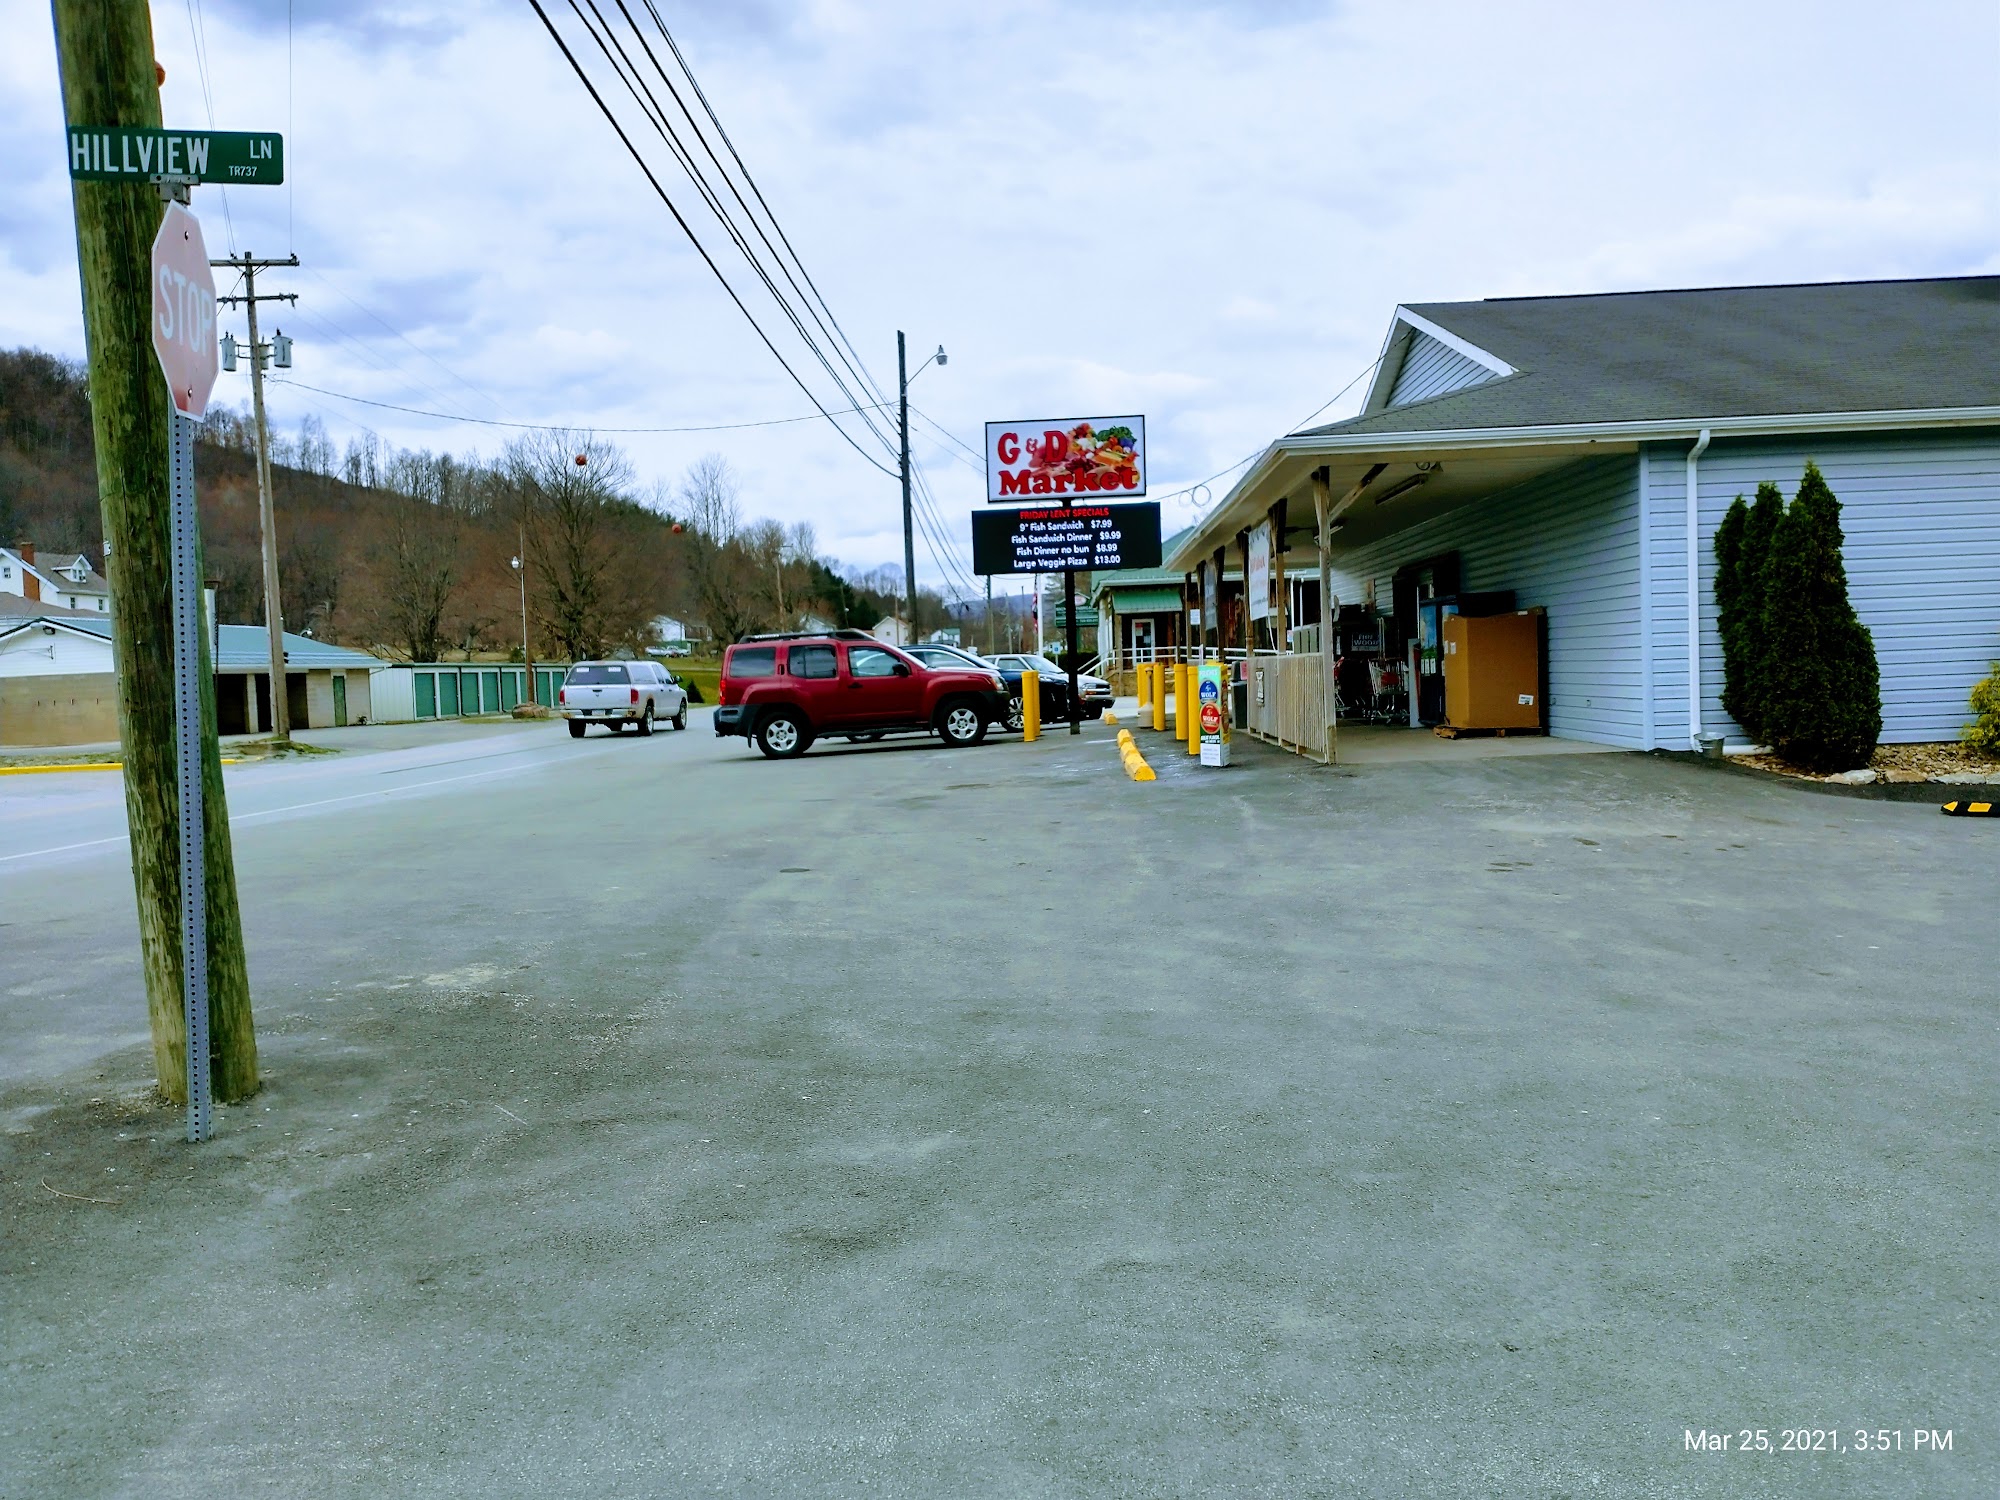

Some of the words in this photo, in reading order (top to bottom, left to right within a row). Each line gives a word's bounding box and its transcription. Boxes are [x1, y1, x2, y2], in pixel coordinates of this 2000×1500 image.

[71, 133, 210, 175] HILLVIEW
[250, 139, 272, 160] LN
[228, 165, 258, 177] TR737
[158, 264, 213, 357] STOP
[997, 432, 1021, 465] G
[1026, 438, 1038, 454] &
[1043, 430, 1068, 463] D
[998, 466, 1138, 496] Market
[1020, 510, 1049, 519] FRIDAY
[1050, 509, 1071, 518] LENT
[1072, 507, 1110, 517] SPECIALS
[1030, 522, 1046, 531] Fish
[1047, 520, 1084, 531] Sandwich
[1090, 519, 1112, 529] $7.99
[1011, 535, 1028, 544] Fish
[1029, 533, 1065, 543] Sandwich
[1066, 532, 1093, 542] Dinner
[1100, 530, 1122, 541] $9.99
[1016, 547, 1032, 556] Fish
[1033, 546, 1060, 555] Dinner
[1073, 544, 1089, 553] bun
[1096, 543, 1118, 553] $8.99
[1013, 559, 1037, 570] Large
[1037, 557, 1066, 569] Veggie
[1067, 557, 1088, 566] Pizza
